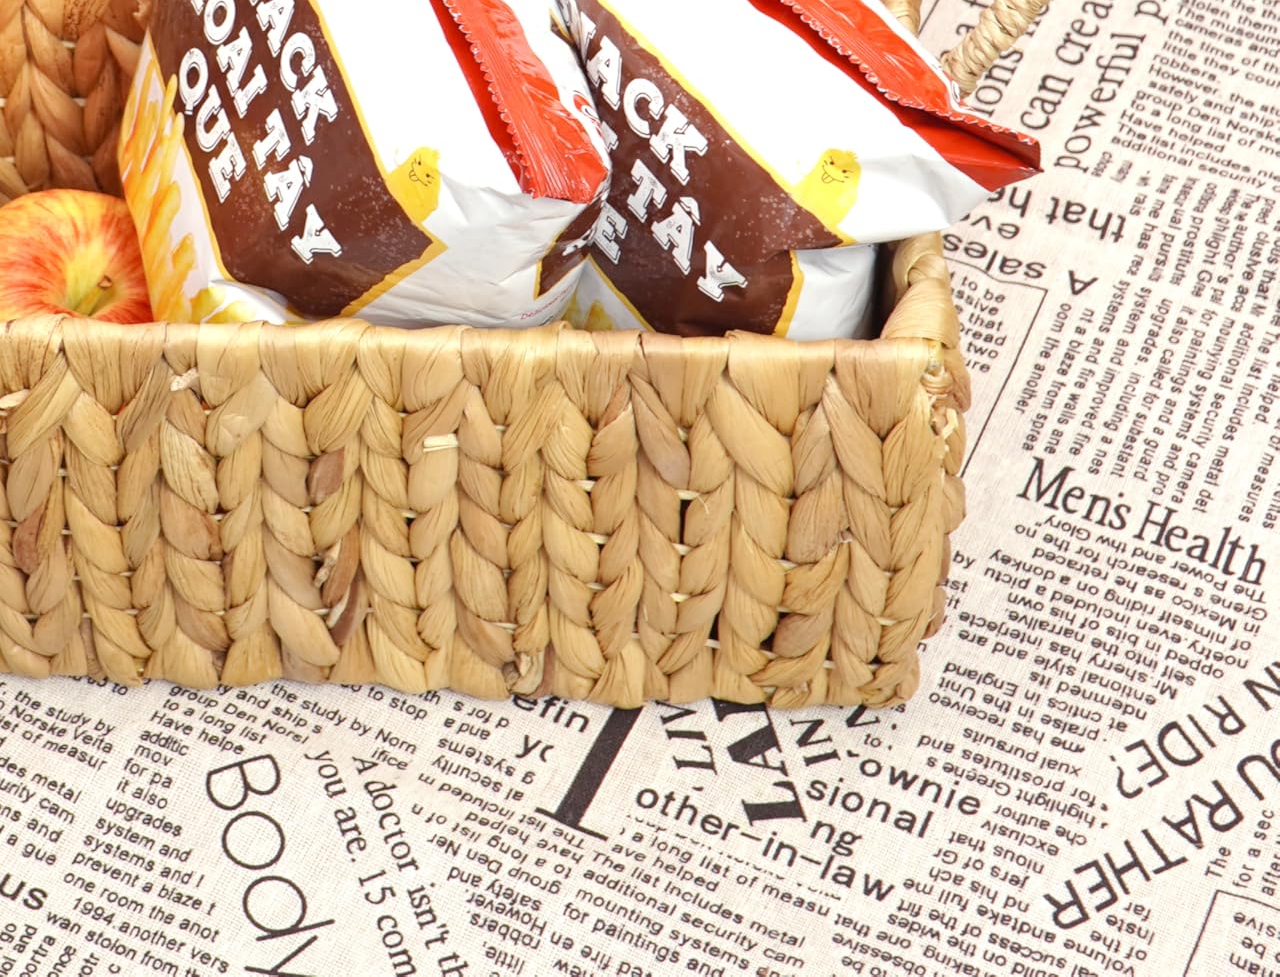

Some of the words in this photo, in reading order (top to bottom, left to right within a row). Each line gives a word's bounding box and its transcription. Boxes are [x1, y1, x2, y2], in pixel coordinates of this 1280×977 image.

[1019, 74, 1075, 131] can
[1053, 32, 1147, 174] powerful
[178, 47, 247, 204] QUE
[1119, 108, 1163, 133] Have
[1167, 127, 1226, 154] helped
[251, 107, 343, 264] TÂY
[627, 158, 749, 304] TÂY
[1045, 196, 1127, 244] that
[1067, 270, 1099, 296] A
[1031, 546, 1109, 581] retraced
[1132, 499, 1267, 586] Health
[1171, 594, 1238, 632] Mexico
[942, 661, 1019, 698] England
[8, 704, 68, 738] Norske
[351, 749, 379, 776] A
[1116, 694, 1247, 800] RIDE?
[30, 772, 83, 804] metal
[961, 748, 1066, 793] prostitutes
[26, 818, 65, 844] and
[95, 816, 156, 852] system
[105, 797, 183, 838] upgrades
[303, 750, 347, 799] you
[333, 806, 367, 863] are.
[357, 869, 397, 906] 15
[363, 780, 420, 872] doctor
[71, 852, 141, 888] prevent
[1042, 779, 1245, 930] RATHER
